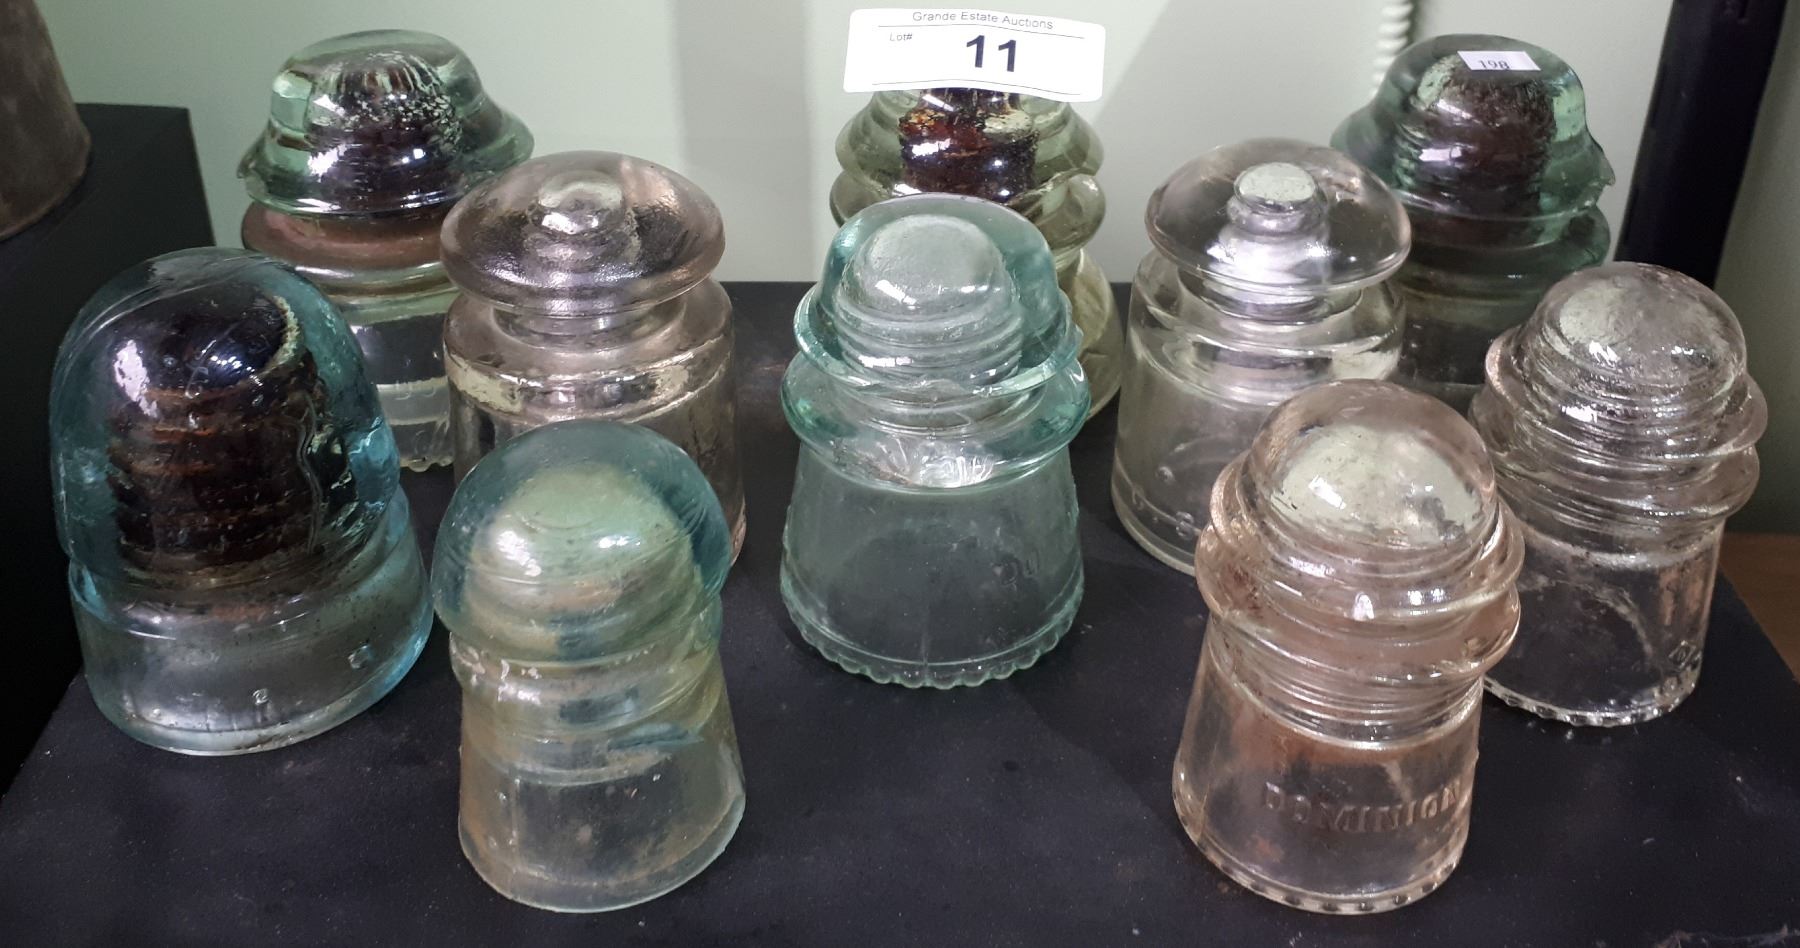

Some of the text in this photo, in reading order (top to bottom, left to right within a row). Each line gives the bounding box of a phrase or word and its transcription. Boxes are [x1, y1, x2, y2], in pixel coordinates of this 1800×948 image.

[913, 11, 1054, 30] Grande Estate Auctions
[889, 32, 913, 42] Lot#
[966, 35, 1017, 73] 11
[1264, 781, 1462, 833] DOMINION
